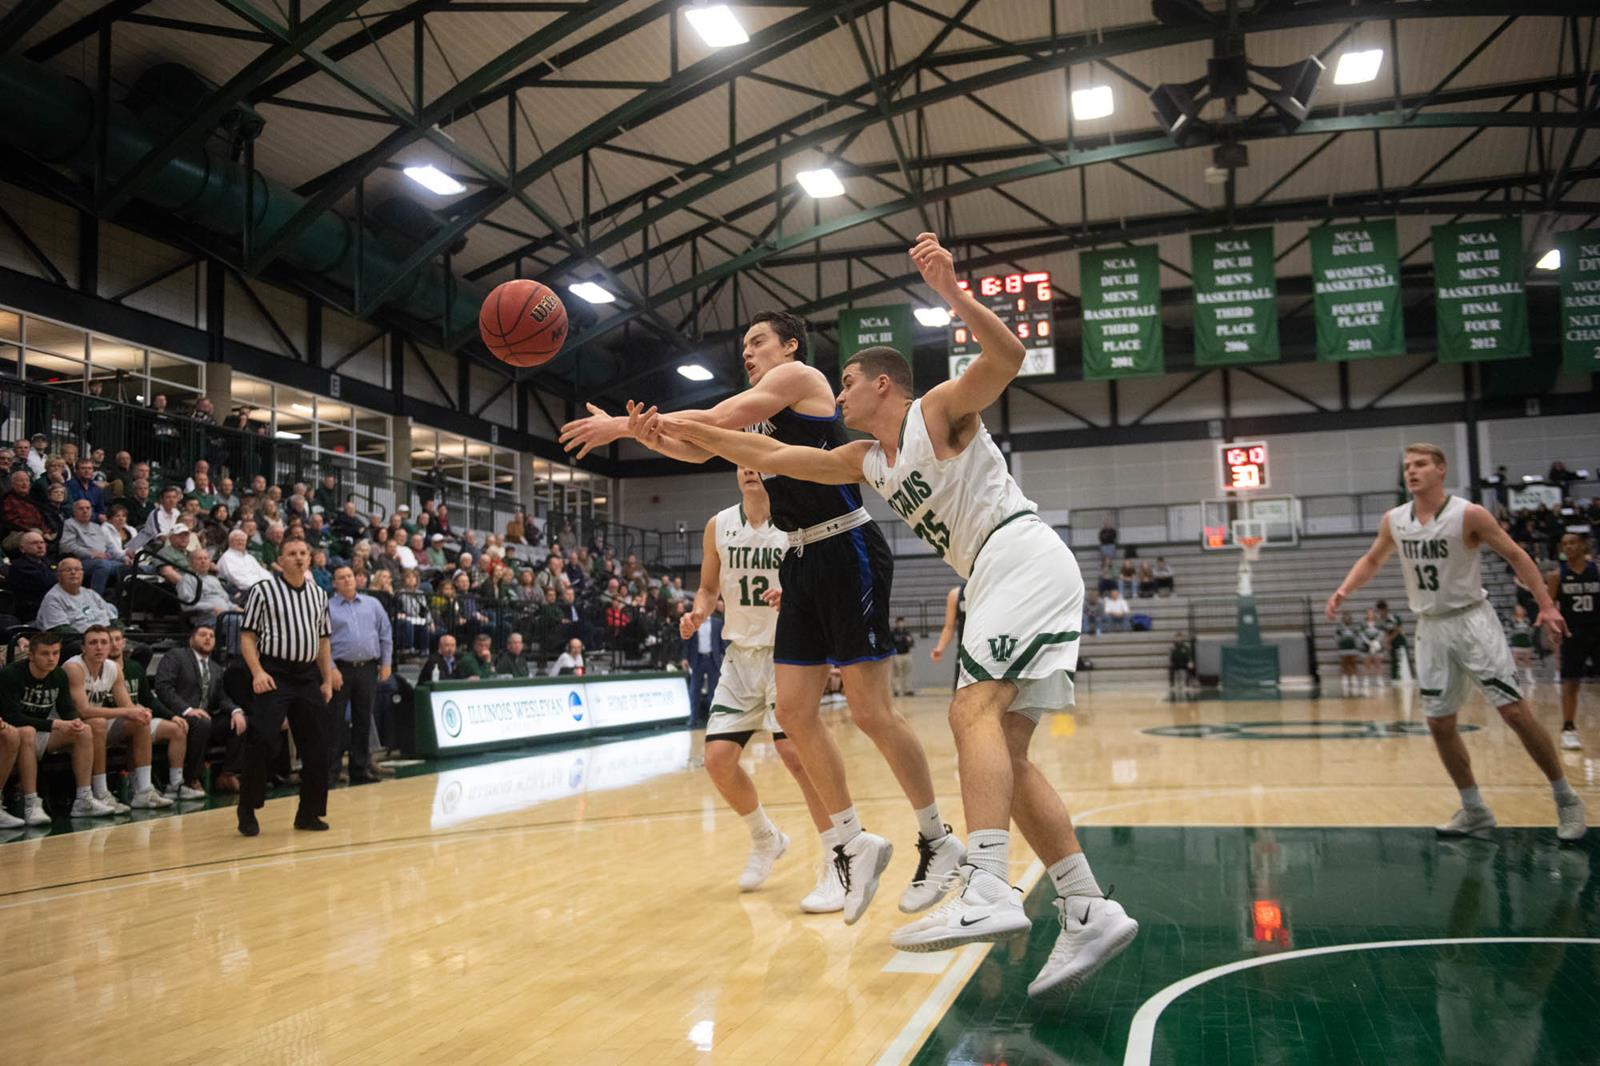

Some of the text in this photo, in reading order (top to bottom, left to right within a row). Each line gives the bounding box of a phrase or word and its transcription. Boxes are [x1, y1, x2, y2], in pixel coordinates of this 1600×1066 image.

[1334, 231, 1371, 243] NCAA
[1459, 232, 1497, 245] NCAA
[1215, 240, 1251, 252] NCAA
[1103, 258, 1136, 269] NCAA
[1315, 275, 1397, 293] BASKETBALL
[1438, 282, 1523, 299] BASKETBALL
[1196, 287, 1274, 304] BASKETBALL
[1084, 304, 1157, 320] BASKETBALL
[1214, 306, 1254, 319] THIRD
[1331, 301, 1384, 316] FOURTH
[1461, 302, 1503, 315] FINAL
[860, 317, 890, 328] NCAA
[1337, 313, 1381, 328] PLACE
[1464, 319, 1501, 332] FOUR
[1101, 323, 1139, 335] THIRD
[1215, 323, 1256, 336] PLACE
[1103, 340, 1141, 352] PLACE
[1470, 337, 1497, 350] 2012
[914, 509, 950, 559] 35
[1401, 539, 1449, 559] TITANS
[728, 546, 782, 569] TITANS
[1414, 564, 1440, 592] 13
[739, 575, 769, 606] 12
[1572, 595, 1593, 612] 20
[468, 697, 564, 724] ILLINOIS WESLEYAN
